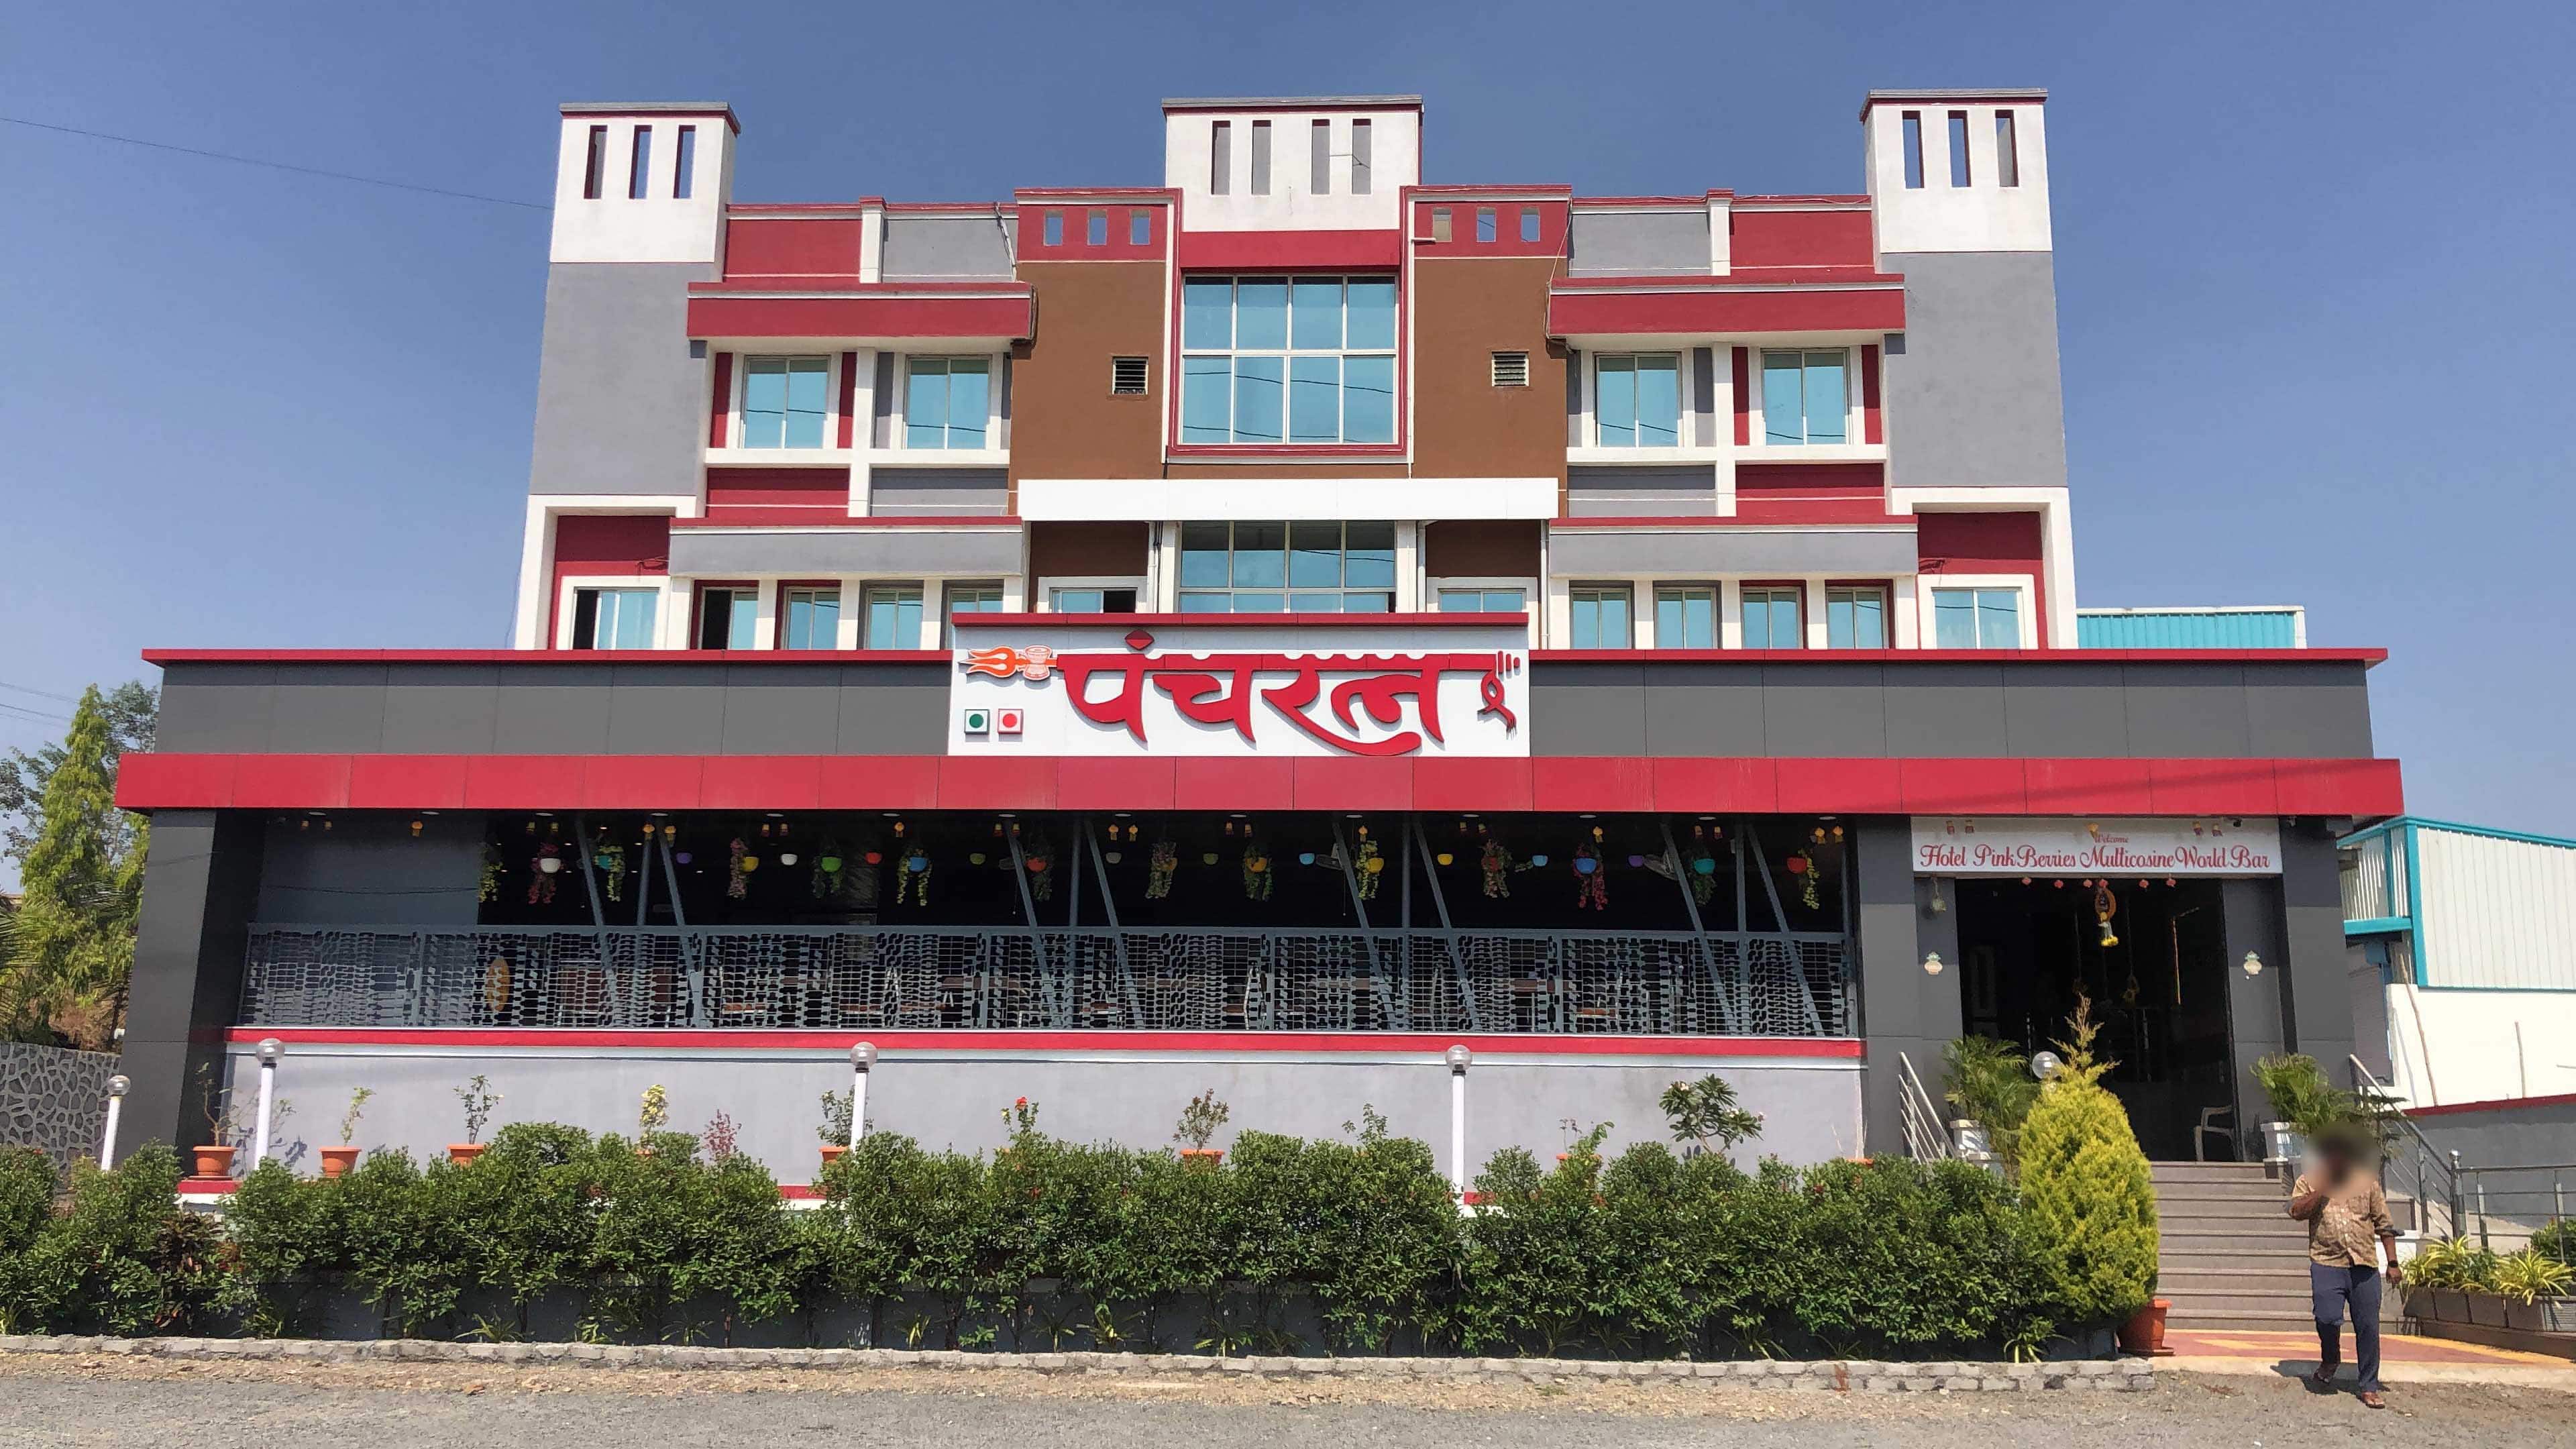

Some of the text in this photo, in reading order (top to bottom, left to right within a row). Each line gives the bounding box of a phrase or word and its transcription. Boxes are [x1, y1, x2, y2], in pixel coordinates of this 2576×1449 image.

[1057, 629, 1499, 756] पंचरत्न
[2094, 832, 2129, 843] Welcome
[1920, 844, 2269, 868] Hotel Pink Berries Multicosine World Bar
